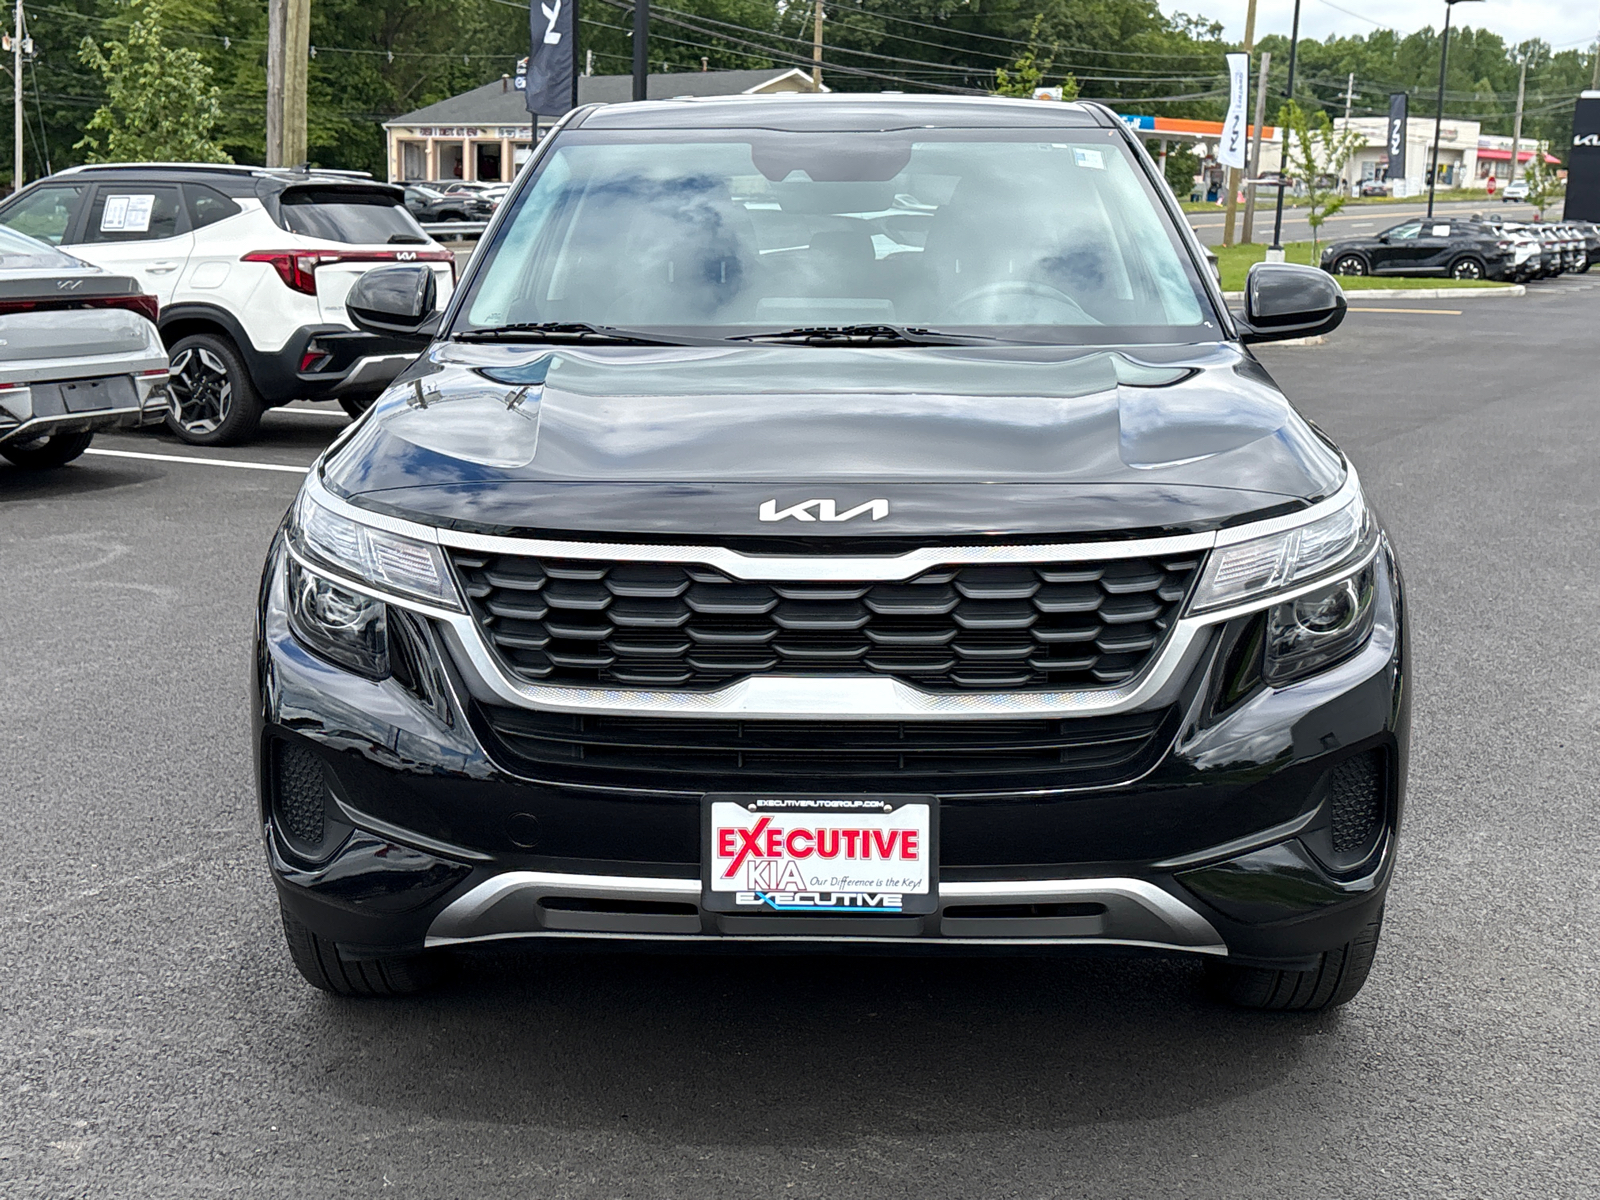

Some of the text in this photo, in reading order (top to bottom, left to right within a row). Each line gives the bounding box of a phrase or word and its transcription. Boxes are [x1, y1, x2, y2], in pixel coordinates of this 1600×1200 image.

[1573, 134, 1600, 146] KI
[396, 252, 417, 261] KIA
[759, 499, 889, 521] KIA
[757, 800, 884, 808] EXECUTIVEAUTOGROUP.COM
[717, 816, 919, 879] EXECUTIVE
[747, 860, 807, 891] KIA
[810, 876, 922, 891] Our Difference is the Key!
[736, 892, 902, 908] EXECUTIVE
